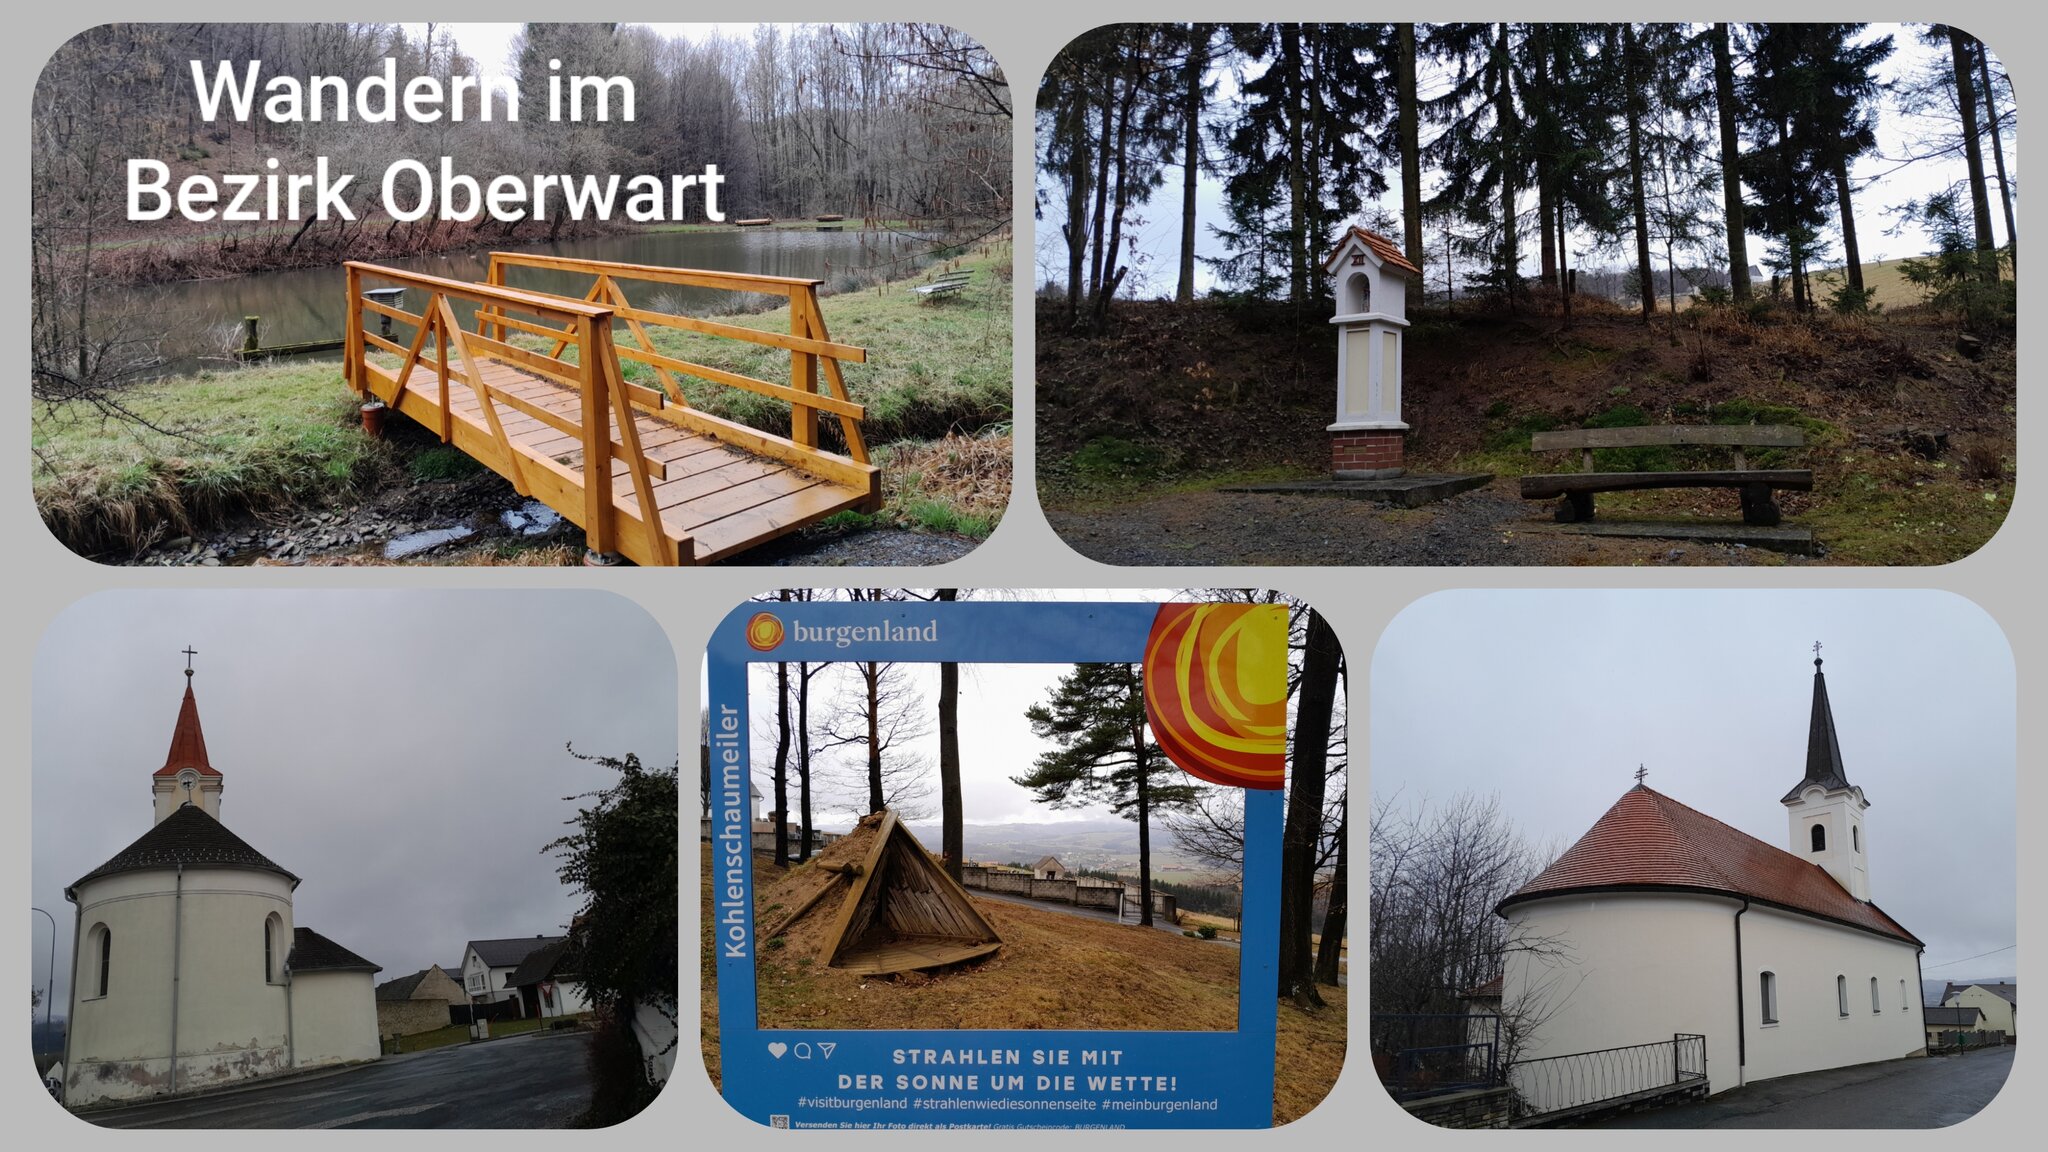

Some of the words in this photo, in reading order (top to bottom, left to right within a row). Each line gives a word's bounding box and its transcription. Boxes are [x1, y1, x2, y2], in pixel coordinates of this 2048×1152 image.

[793, 619, 939, 649] burgenland
[716, 704, 746, 958] Kohlenschaumeiler
[893, 1049, 1020, 1065] STRAHLEN
[1032, 1049, 1070, 1065] SIE
[1081, 1050, 1123, 1065] MIT
[838, 1074, 885, 1090] DER
[896, 1074, 979, 1090] SONNE
[990, 1075, 1024, 1091] UM
[1037, 1075, 1075, 1091] DIE
[1087, 1076, 1177, 1092] WETTE!
[798, 1096, 908, 1111] #visitburgenland
[913, 1097, 1097, 1110] #strahlenwiediesonnenseite
[1101, 1098, 1218, 1113] #meinburgenland
[839, 1121, 853, 1129] Sie
[854, 1121, 871, 1129] hier
[888, 1122, 906, 1130] Foto
[908, 1122, 933, 1130] direkt
